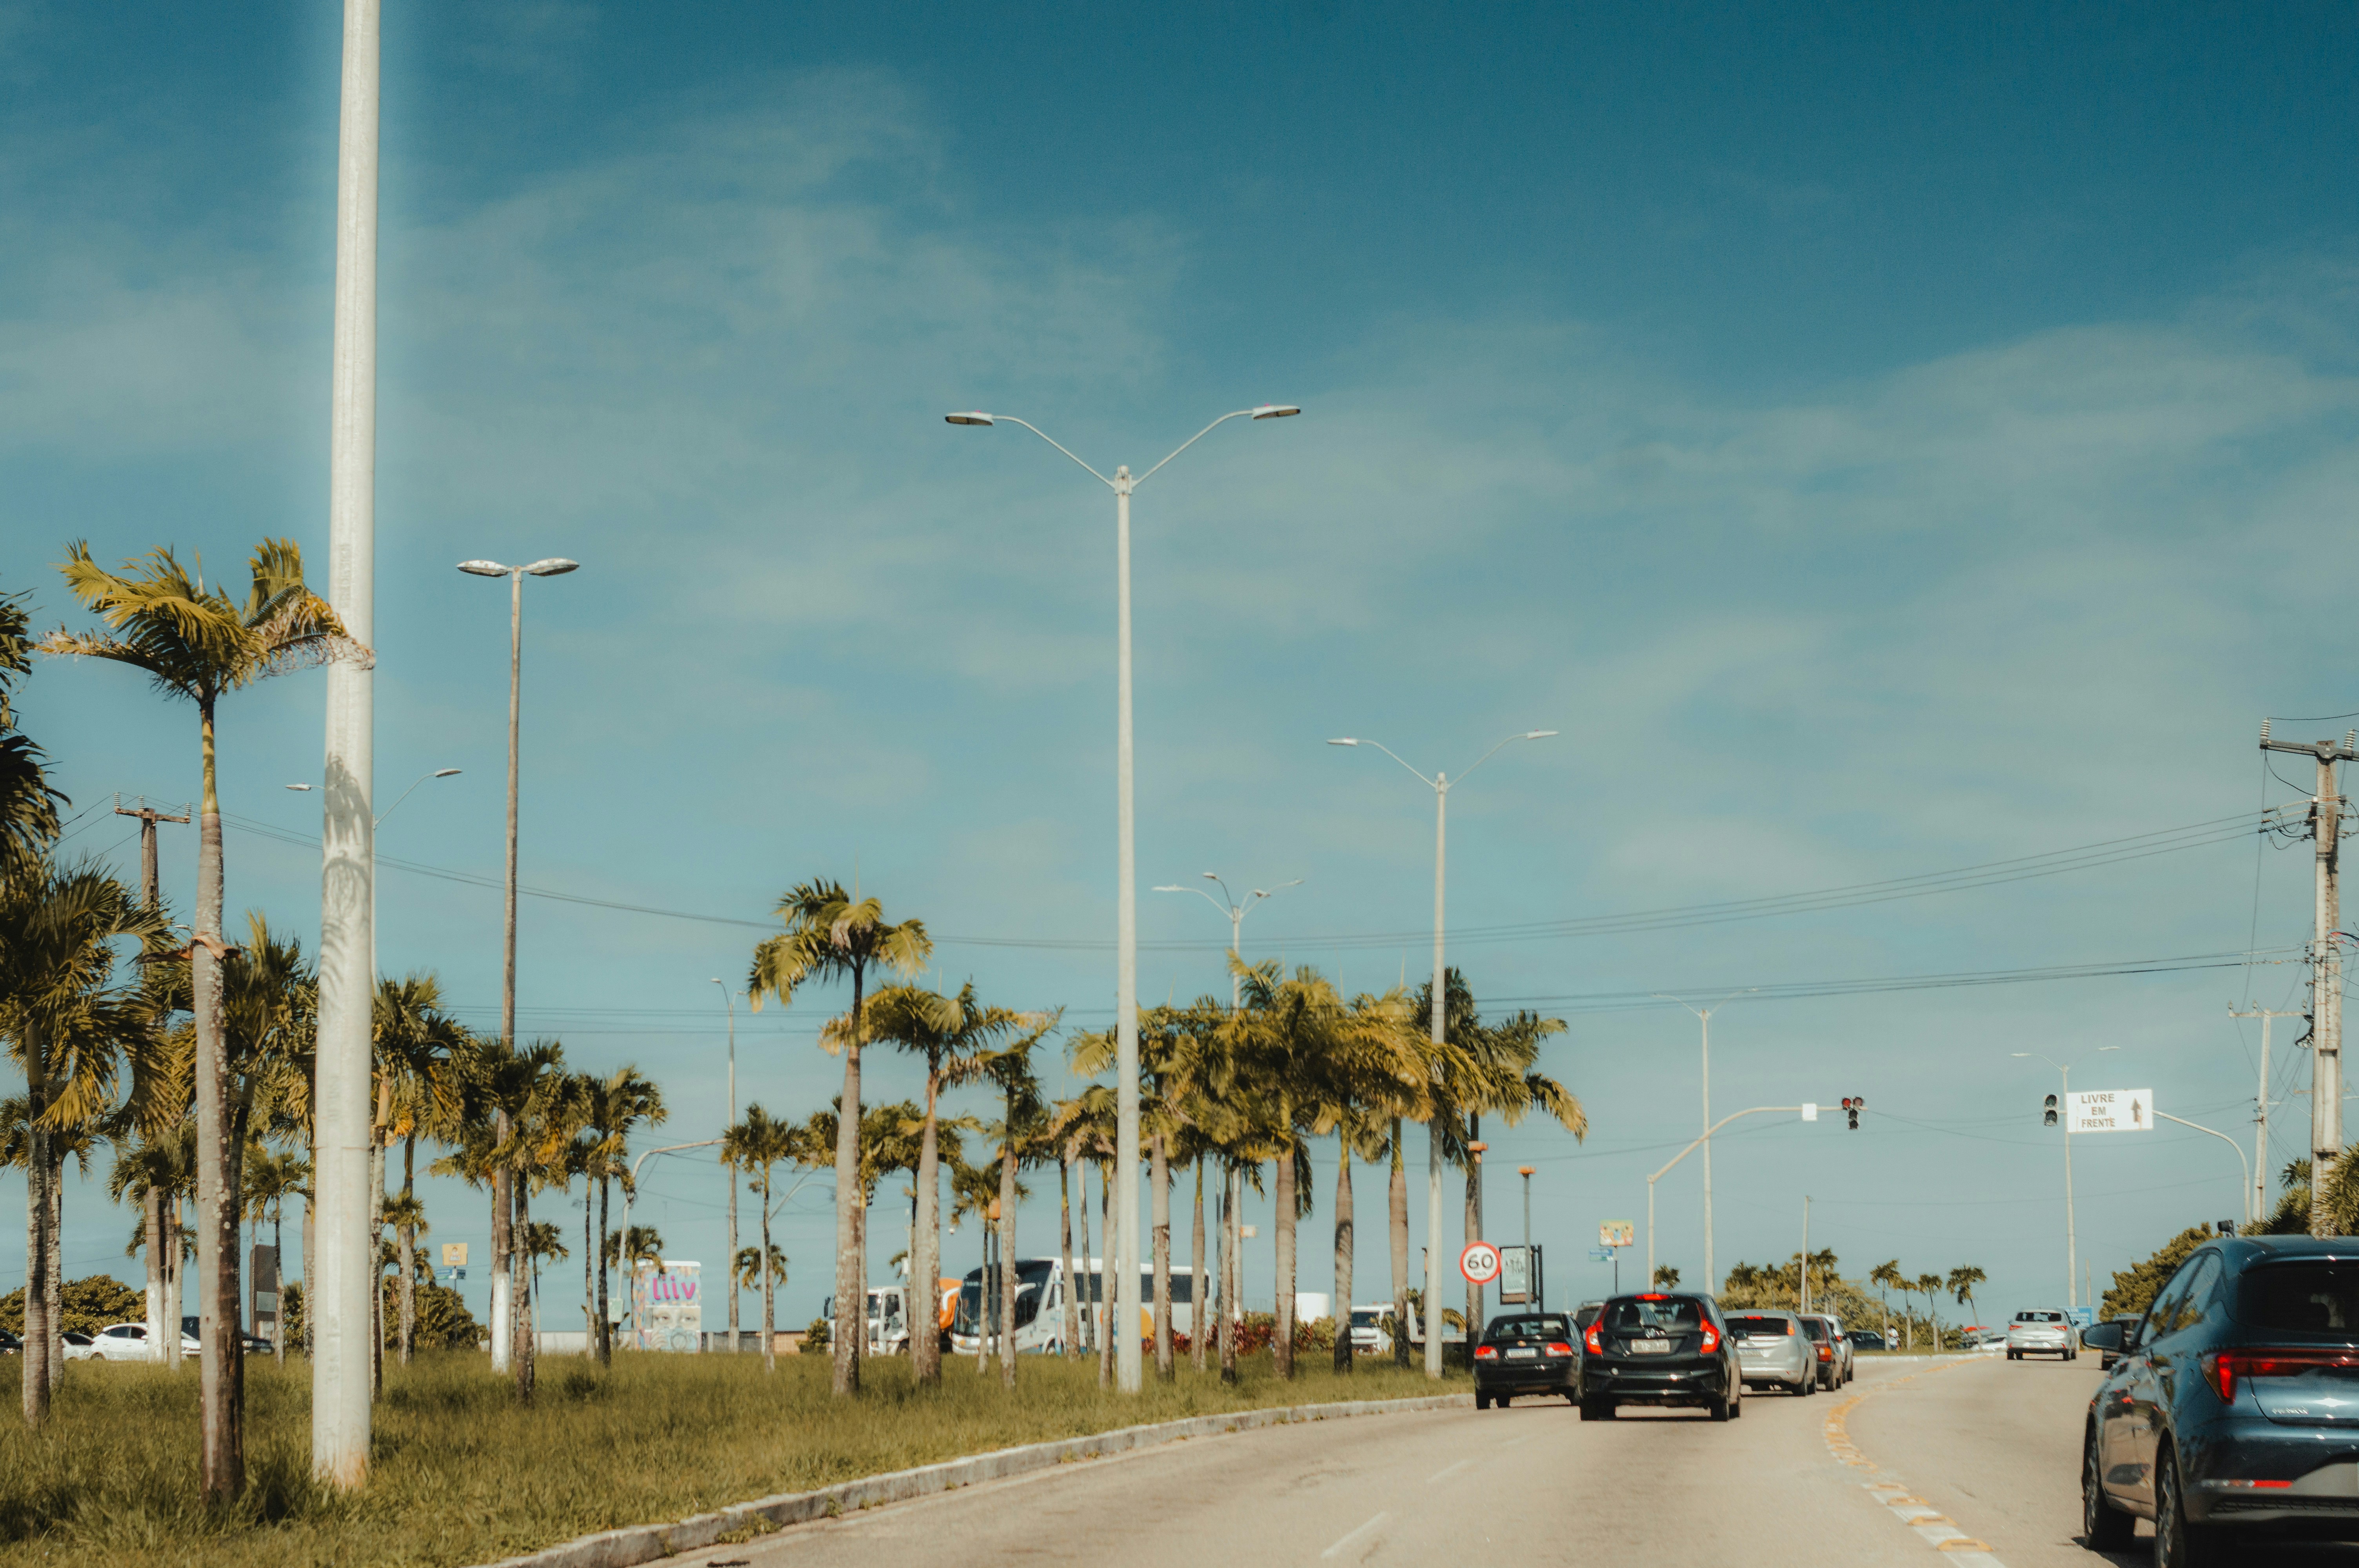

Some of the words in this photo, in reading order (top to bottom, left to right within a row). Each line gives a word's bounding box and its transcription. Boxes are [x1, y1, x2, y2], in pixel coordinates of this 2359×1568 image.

[2081, 1093, 2115, 1103] LIVRE
[2091, 1106, 2106, 1115] EM
[2081, 1118, 2115, 1128] FRENTE
[1467, 1253, 1493, 1270] 60
